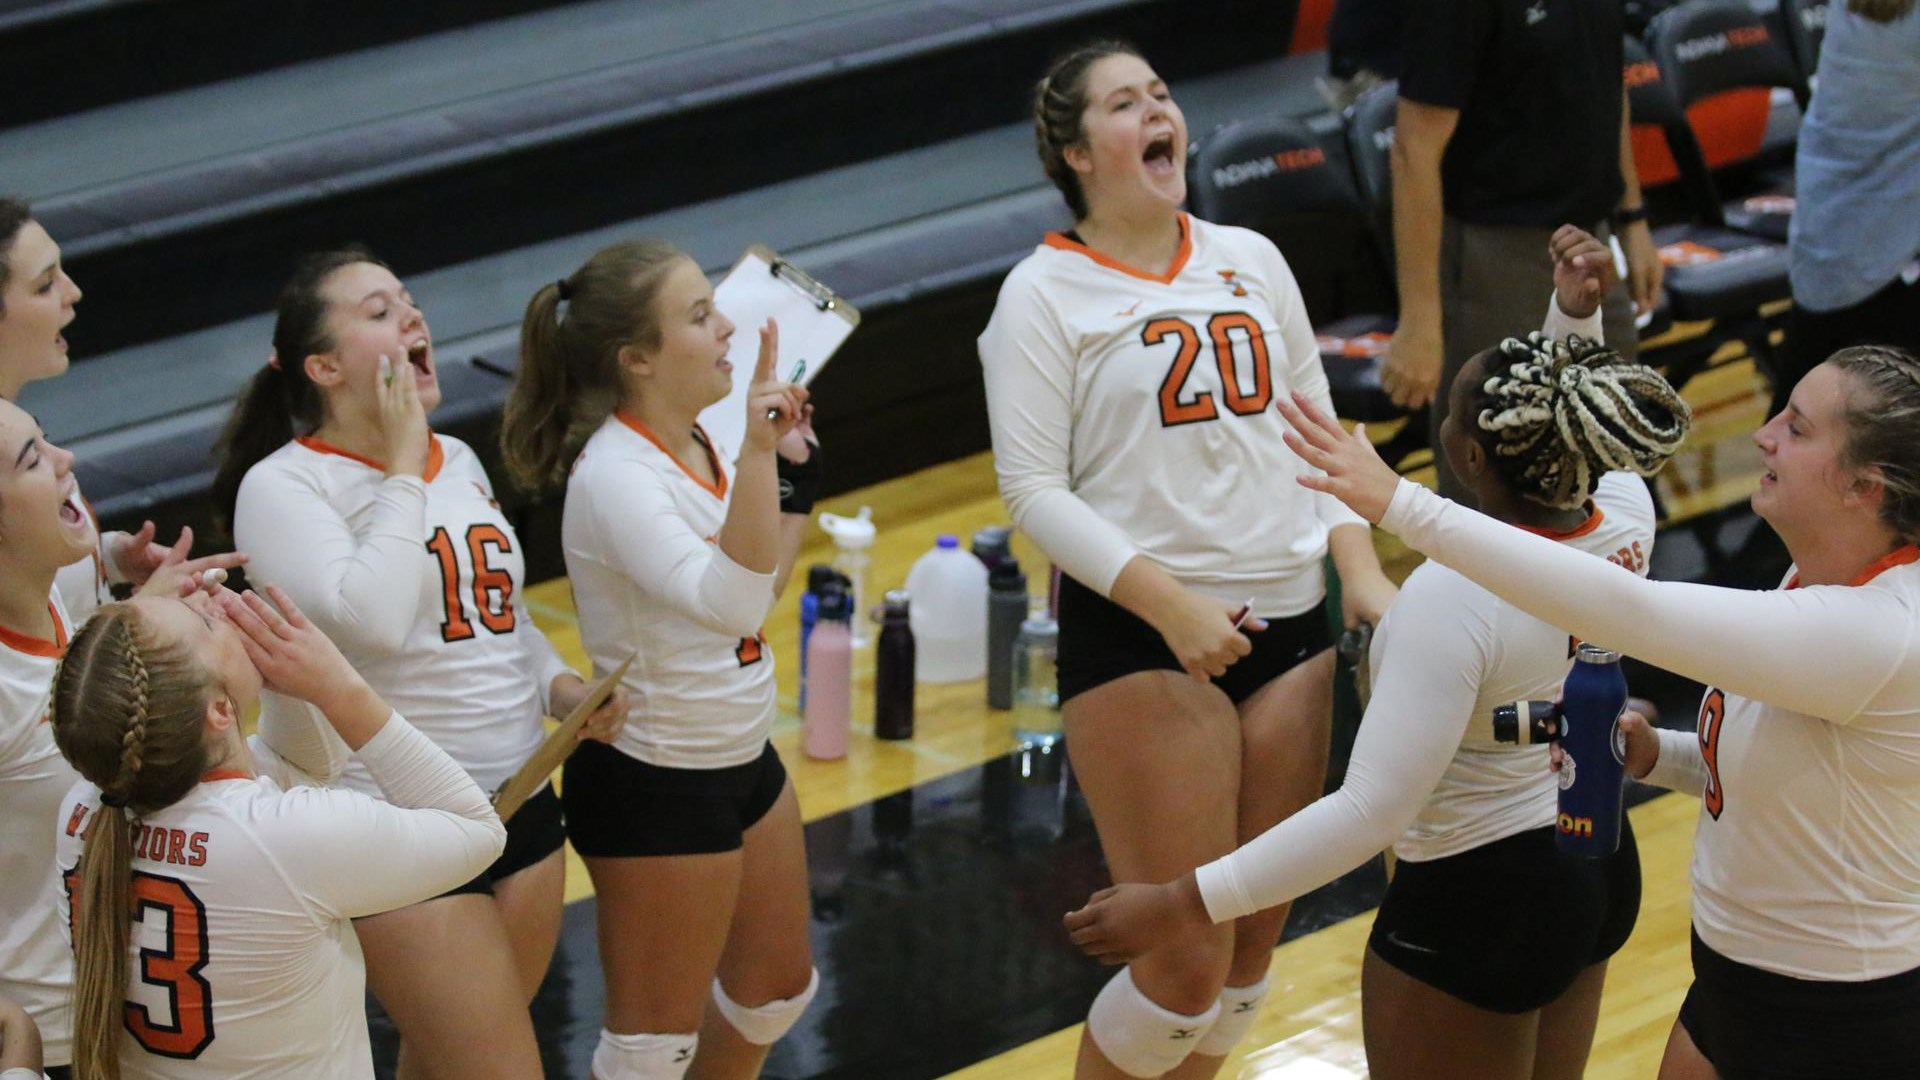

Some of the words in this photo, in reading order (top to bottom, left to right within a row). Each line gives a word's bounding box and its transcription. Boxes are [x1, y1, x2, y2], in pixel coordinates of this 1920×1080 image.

[1140, 311, 1273, 428] 20
[425, 523, 515, 643] 16
[1698, 687, 1725, 822] 9
[65, 802, 209, 867] WIORS
